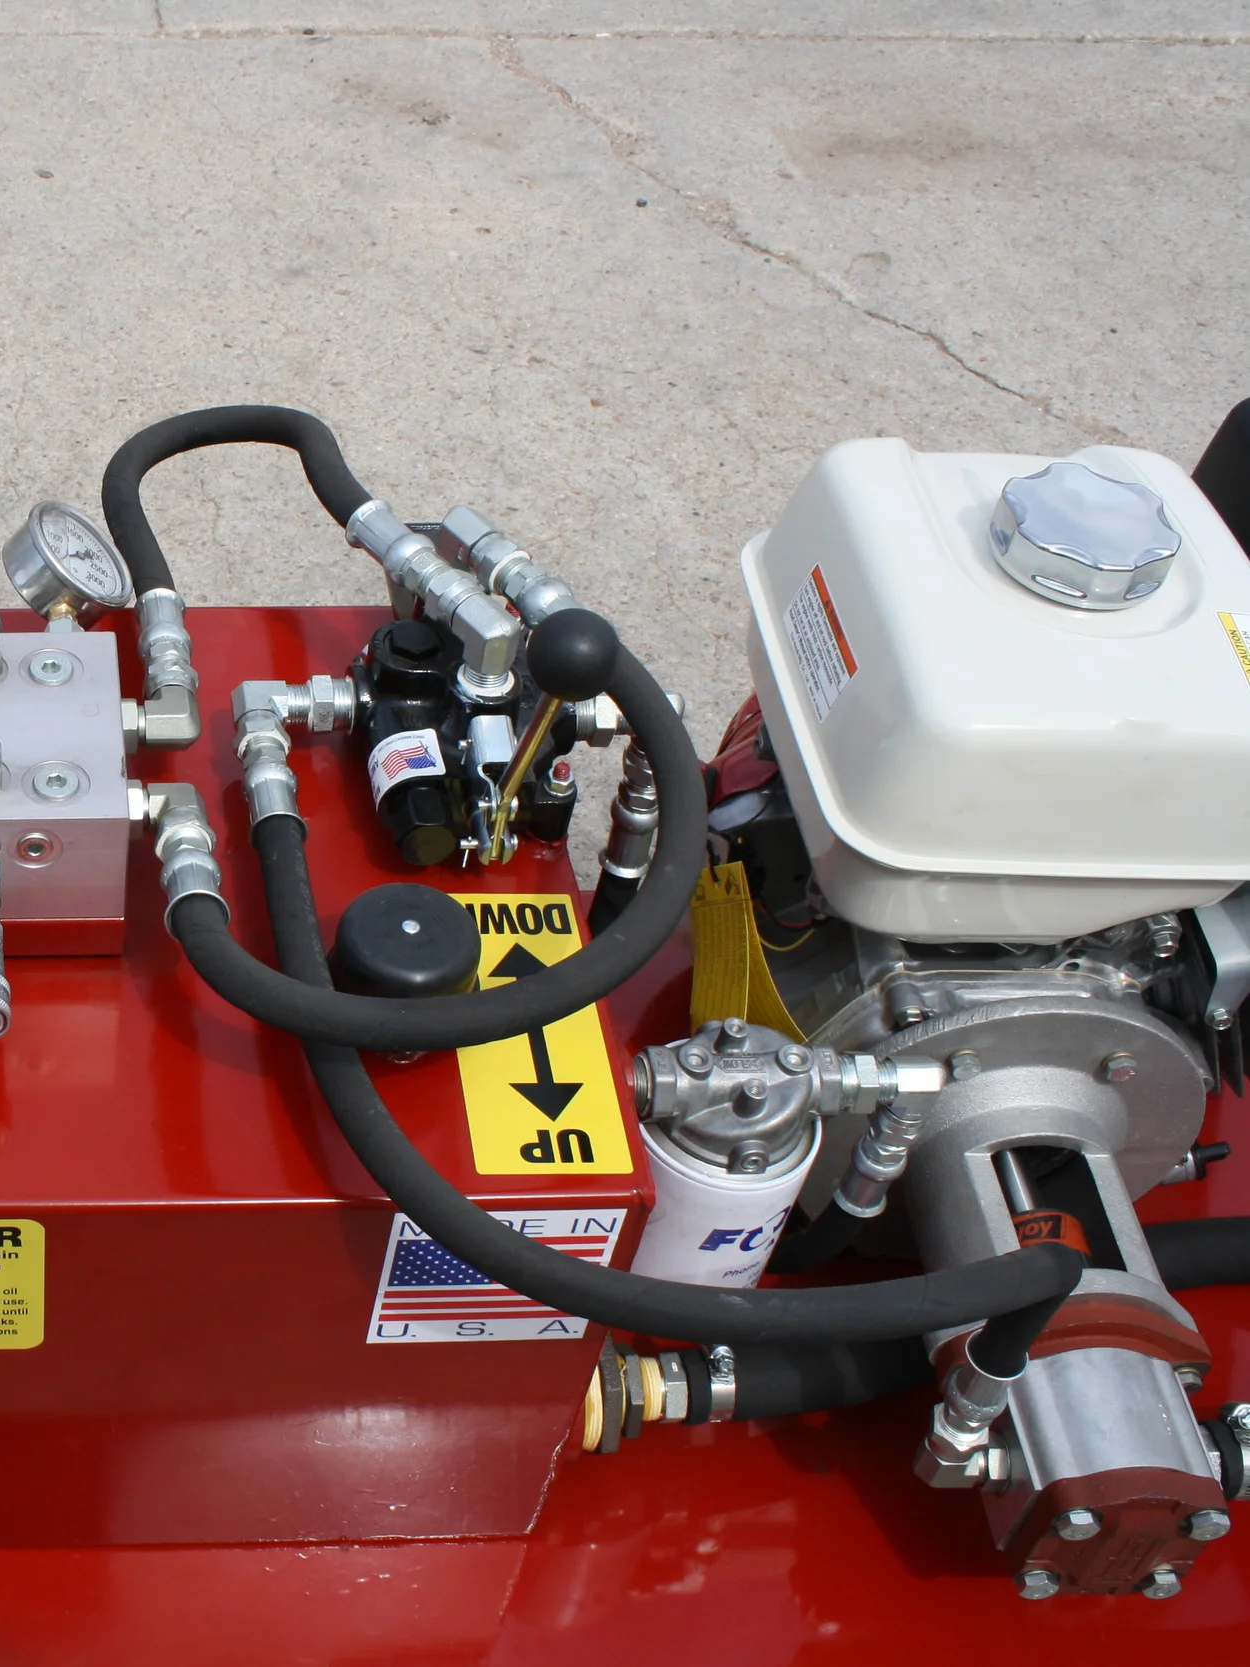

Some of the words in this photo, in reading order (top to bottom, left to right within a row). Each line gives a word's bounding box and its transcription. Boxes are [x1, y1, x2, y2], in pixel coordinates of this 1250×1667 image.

[1227, 629, 1250, 666] CAUTION
[519, 1128, 595, 1163] UP
[570, 1217, 617, 1234] IN
[3, 1287, 18, 1295] oil
[376, 1323, 417, 1338] U.
[456, 1321, 494, 1336] S.
[537, 1319, 578, 1334] A.
